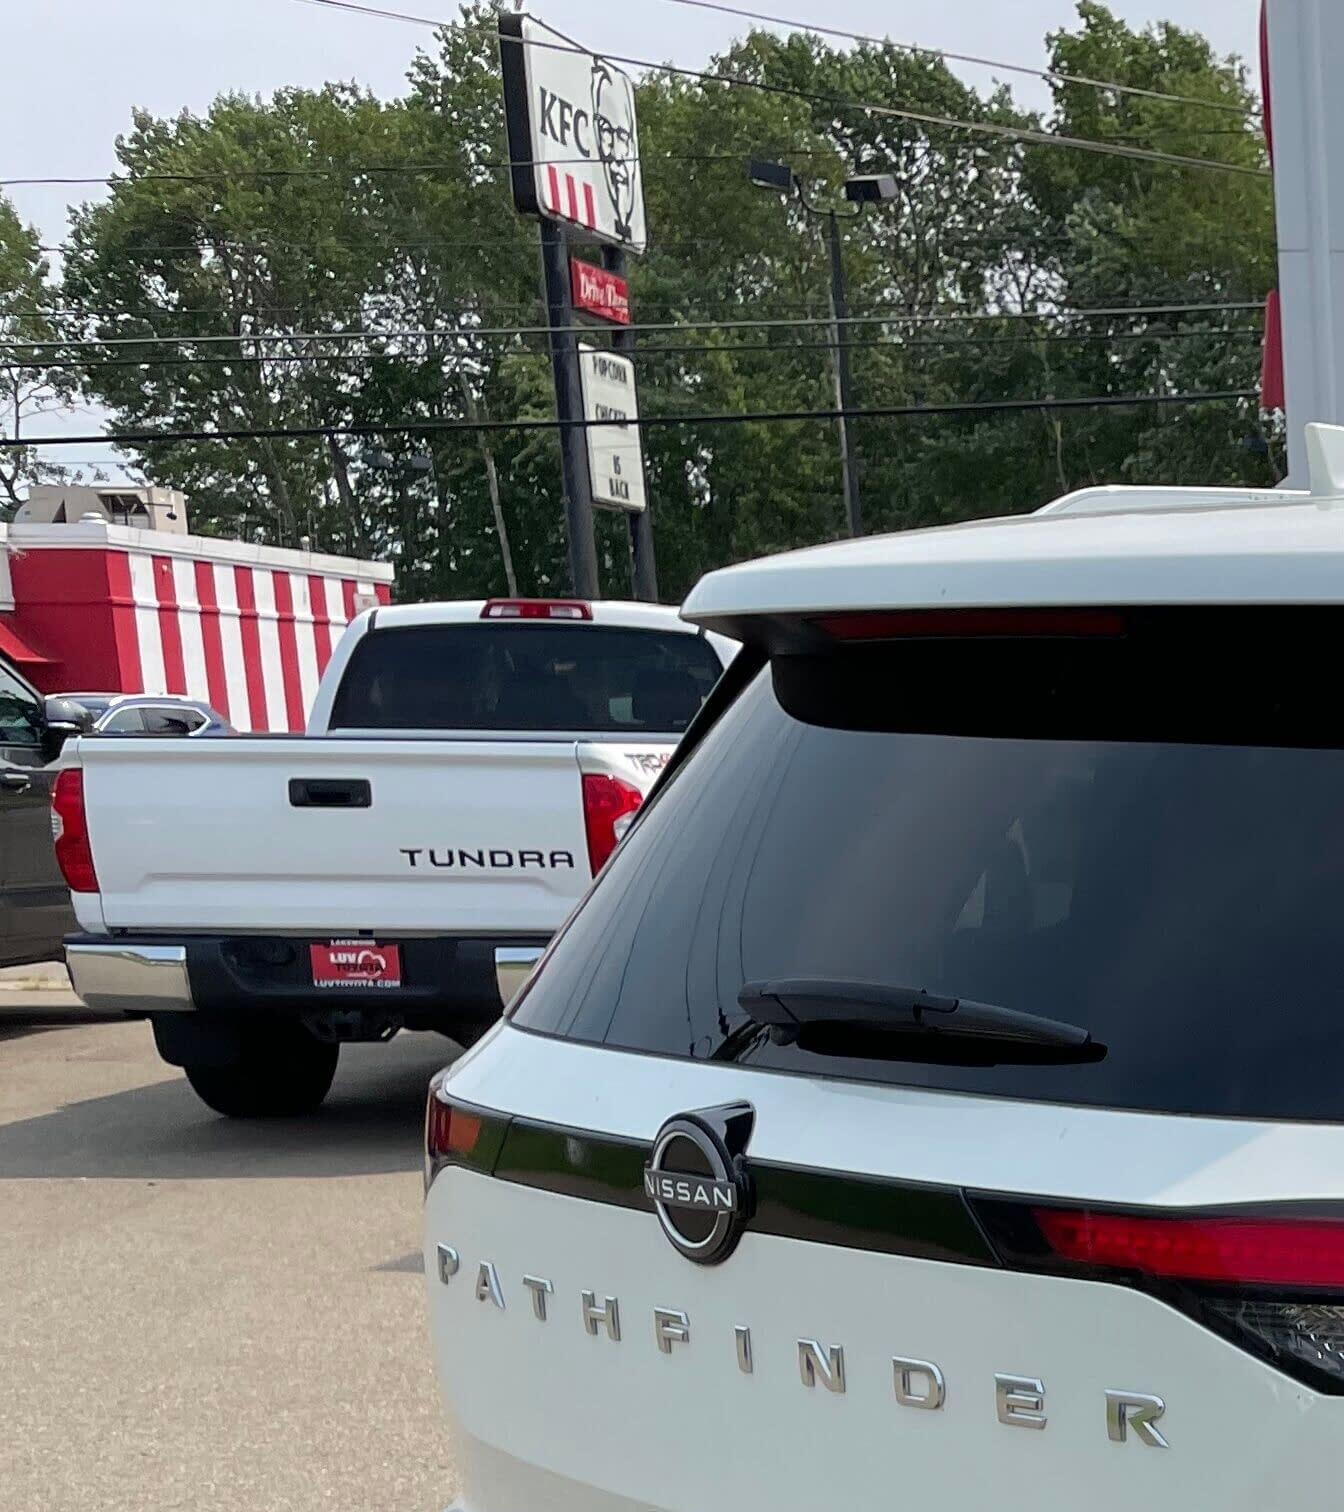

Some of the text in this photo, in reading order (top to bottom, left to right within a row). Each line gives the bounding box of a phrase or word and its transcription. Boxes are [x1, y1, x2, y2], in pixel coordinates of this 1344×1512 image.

[539, 85, 590, 158] KFC
[609, 478, 629, 500] BACK
[399, 848, 575, 868] TUNDRA
[330, 952, 358, 964] LUV
[645, 1173, 732, 1208] NISSAN
[436, 1241, 1170, 1449] PATHFINDER
